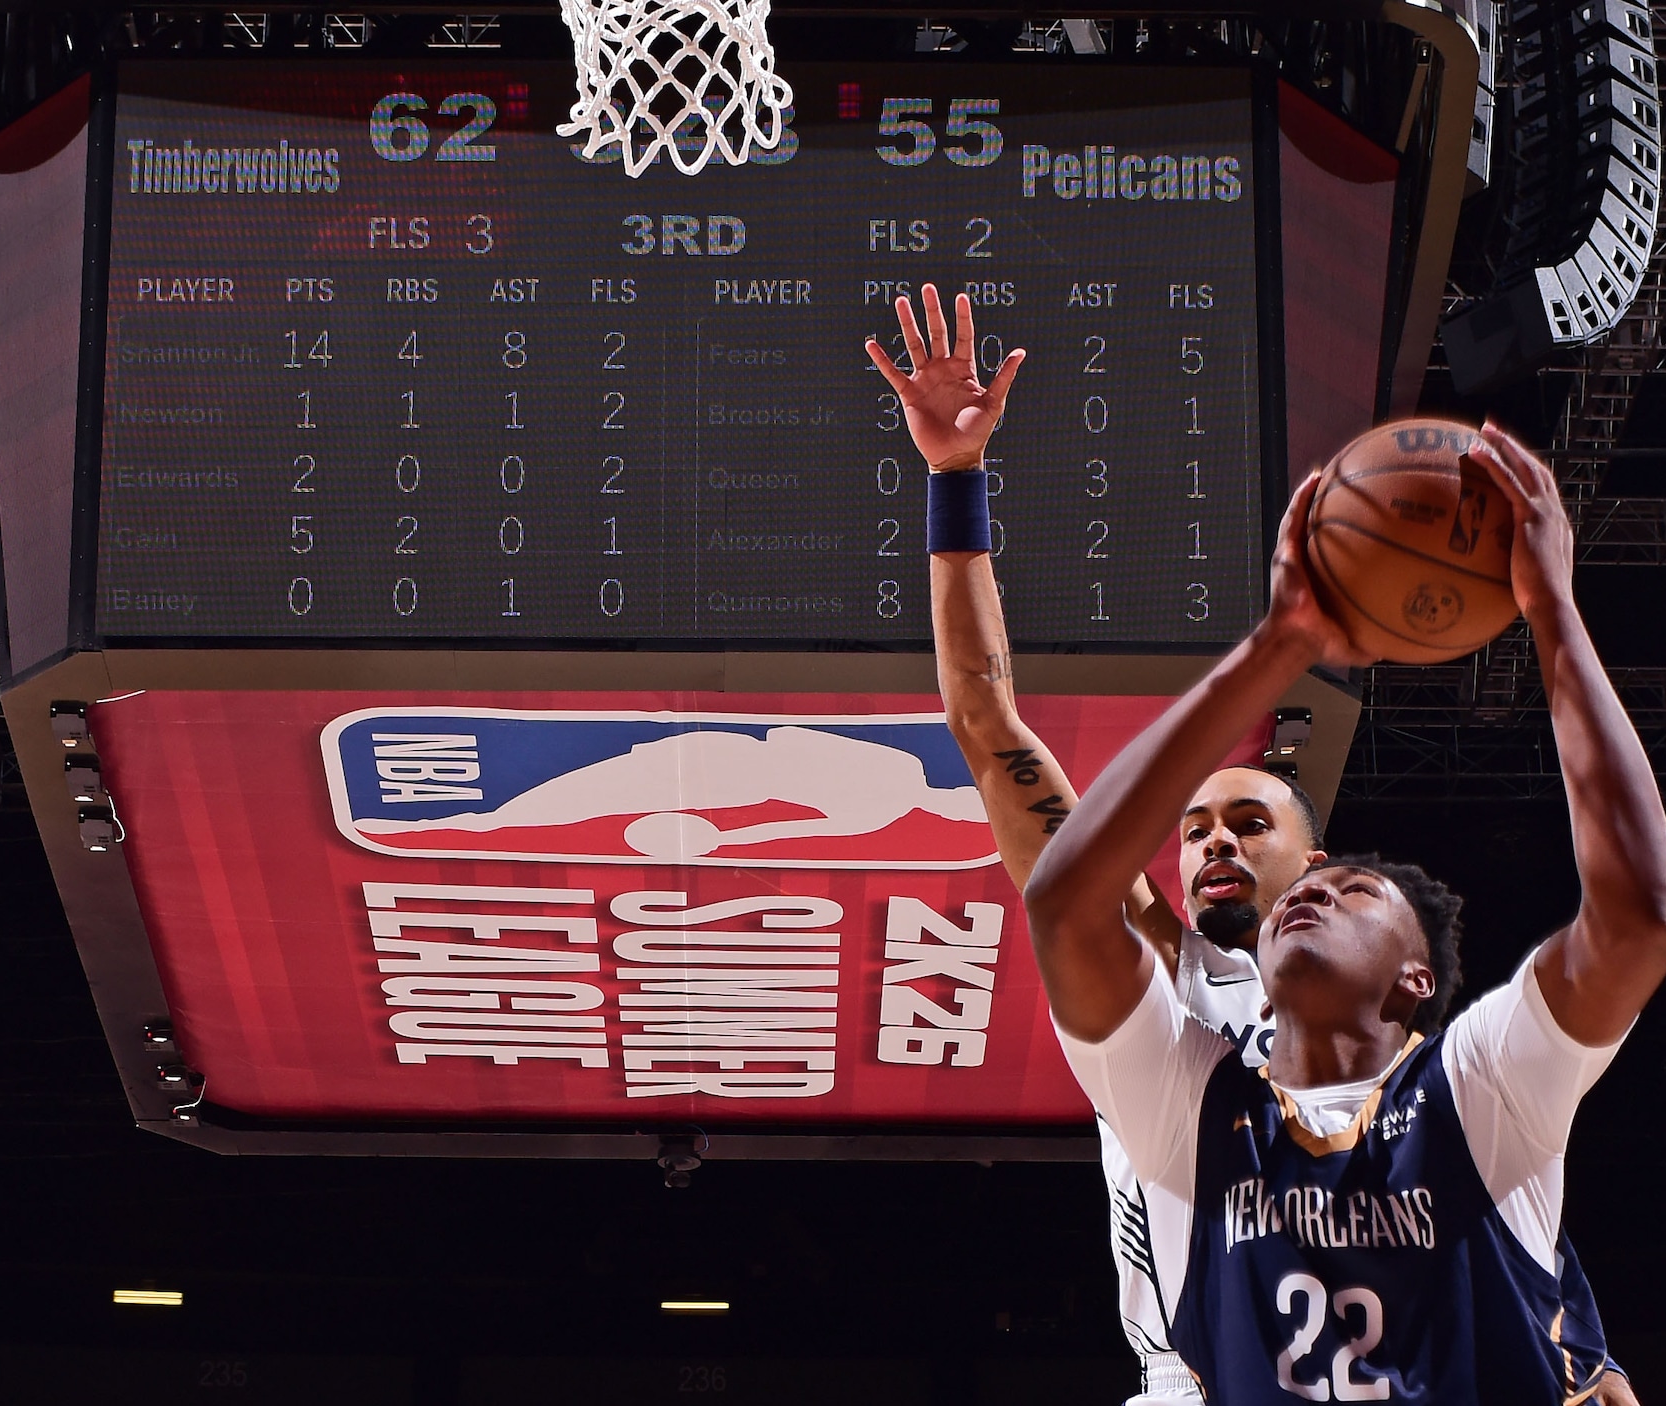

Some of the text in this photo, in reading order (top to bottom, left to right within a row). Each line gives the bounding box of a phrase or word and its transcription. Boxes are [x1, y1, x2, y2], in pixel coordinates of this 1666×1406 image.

[369, 92, 497, 162] 62
[875, 98, 1003, 167] 55
[127, 140, 340, 194] Timberwolves
[1021, 144, 1242, 202] Pelicans
[369, 213, 494, 254] FLS 3
[621, 214, 747, 256] 3RD
[868, 217, 993, 258] FLS 2
[136, 278, 638, 303] PLAYER PTS RBS AST FLS
[714, 278, 1215, 310] PLAYER PTS RBS AST FLS
[283, 330, 333, 369] 14
[398, 330, 423, 368] 4
[502, 331, 527, 369] 8
[602, 331, 626, 370] 2
[1083, 336, 1107, 374] 2
[1180, 337, 1205, 375] 5
[296, 390, 316, 428] 1
[400, 390, 420, 428] 1
[504, 390, 524, 428] 1
[602, 391, 626, 429] 2
[876, 393, 900, 431] 3
[1084, 396, 1108, 433] 0
[1185, 397, 1205, 435] 1
[291, 455, 316, 493] 2
[395, 455, 421, 493] 0
[500, 455, 525, 493] 0
[600, 456, 626, 494] 2
[876, 458, 902, 496] 0
[1085, 460, 1109, 498] 3
[1186, 461, 1207, 499] 1
[289, 515, 314, 554] 5
[395, 516, 418, 554] 2
[498, 516, 524, 554] 0
[602, 516, 623, 555] 1
[877, 519, 901, 557] 2
[1086, 521, 1110, 559] 2
[1187, 522, 1208, 560] 1
[288, 577, 313, 616] 0
[393, 577, 418, 616] 0
[501, 577, 521, 617] 1
[599, 577, 625, 616] 0
[876, 580, 902, 619] 8
[1090, 582, 1110, 621] 1
[1186, 582, 1210, 622] 3
[371, 732, 484, 804] NBA
[361, 881, 611, 1069] LEAGUE
[609, 890, 846, 1100] SUMMER
[876, 896, 1006, 1069] 2K26
[1224, 1178, 1436, 1256] NEW ORLEANS
[1275, 1271, 1390, 1402] 22
[678, 1366, 726, 1392] 236
